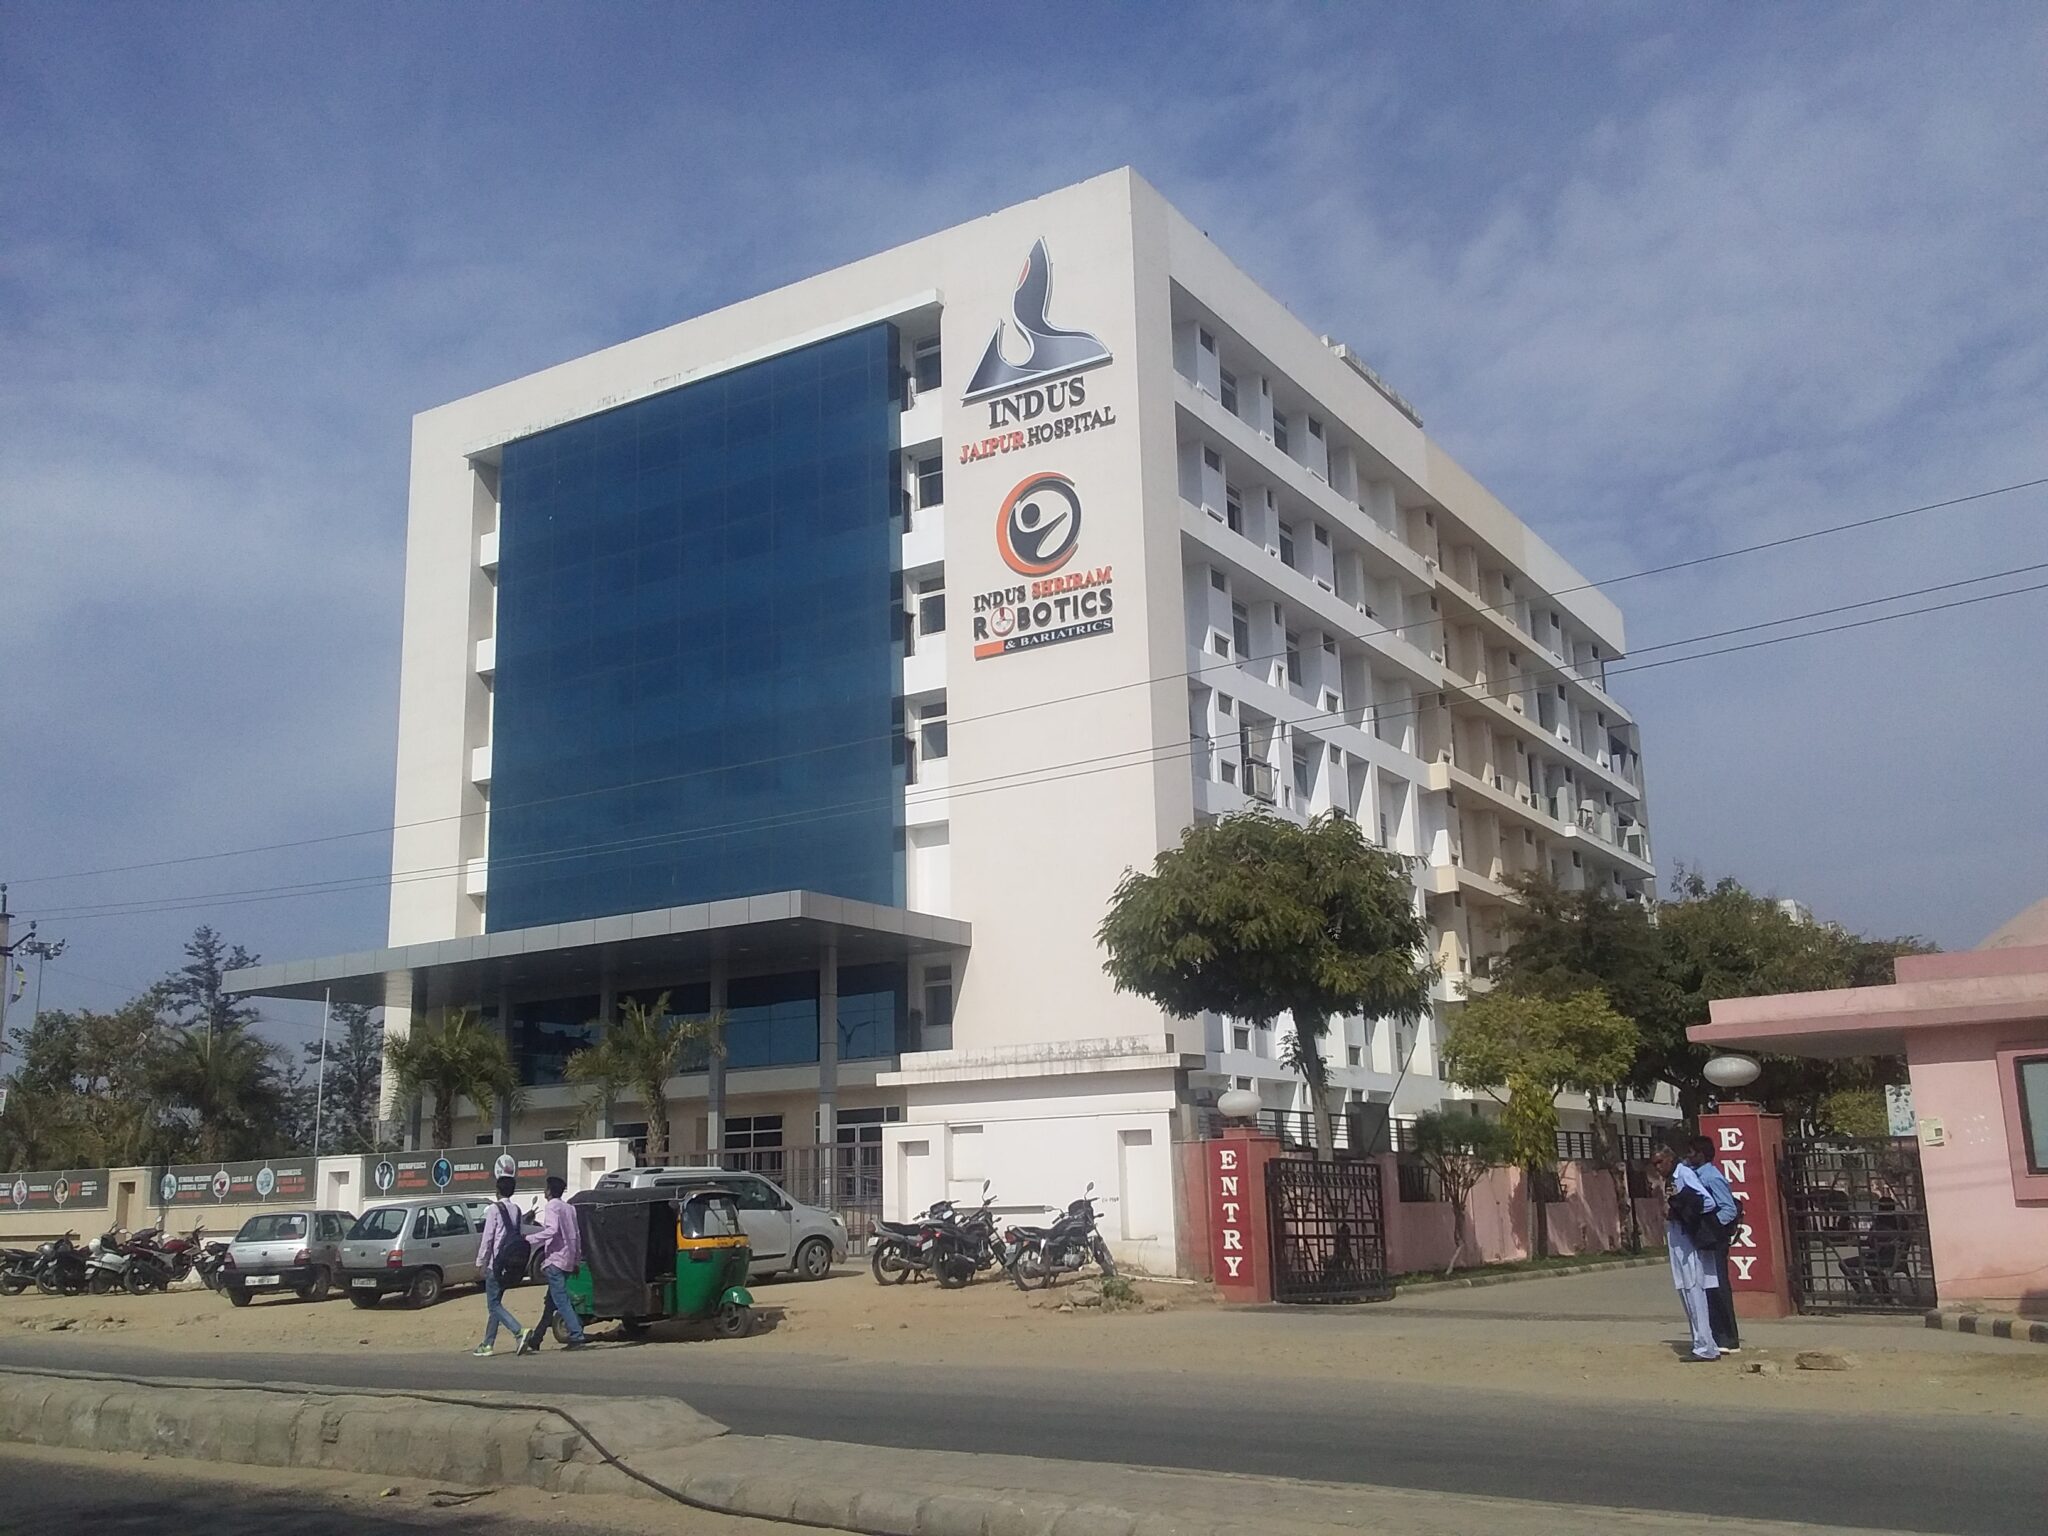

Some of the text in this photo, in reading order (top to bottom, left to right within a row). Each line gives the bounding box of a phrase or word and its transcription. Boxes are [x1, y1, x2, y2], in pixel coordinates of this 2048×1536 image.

[988, 376, 1086, 429] INDUS
[960, 406, 1116, 464] JAIPUR HOSPITAL
[973, 566, 1112, 613] INDUS SHRIRAM
[1005, 619, 1112, 650] & BARIATRICS
[1220, 1150, 1243, 1277] ENTRY
